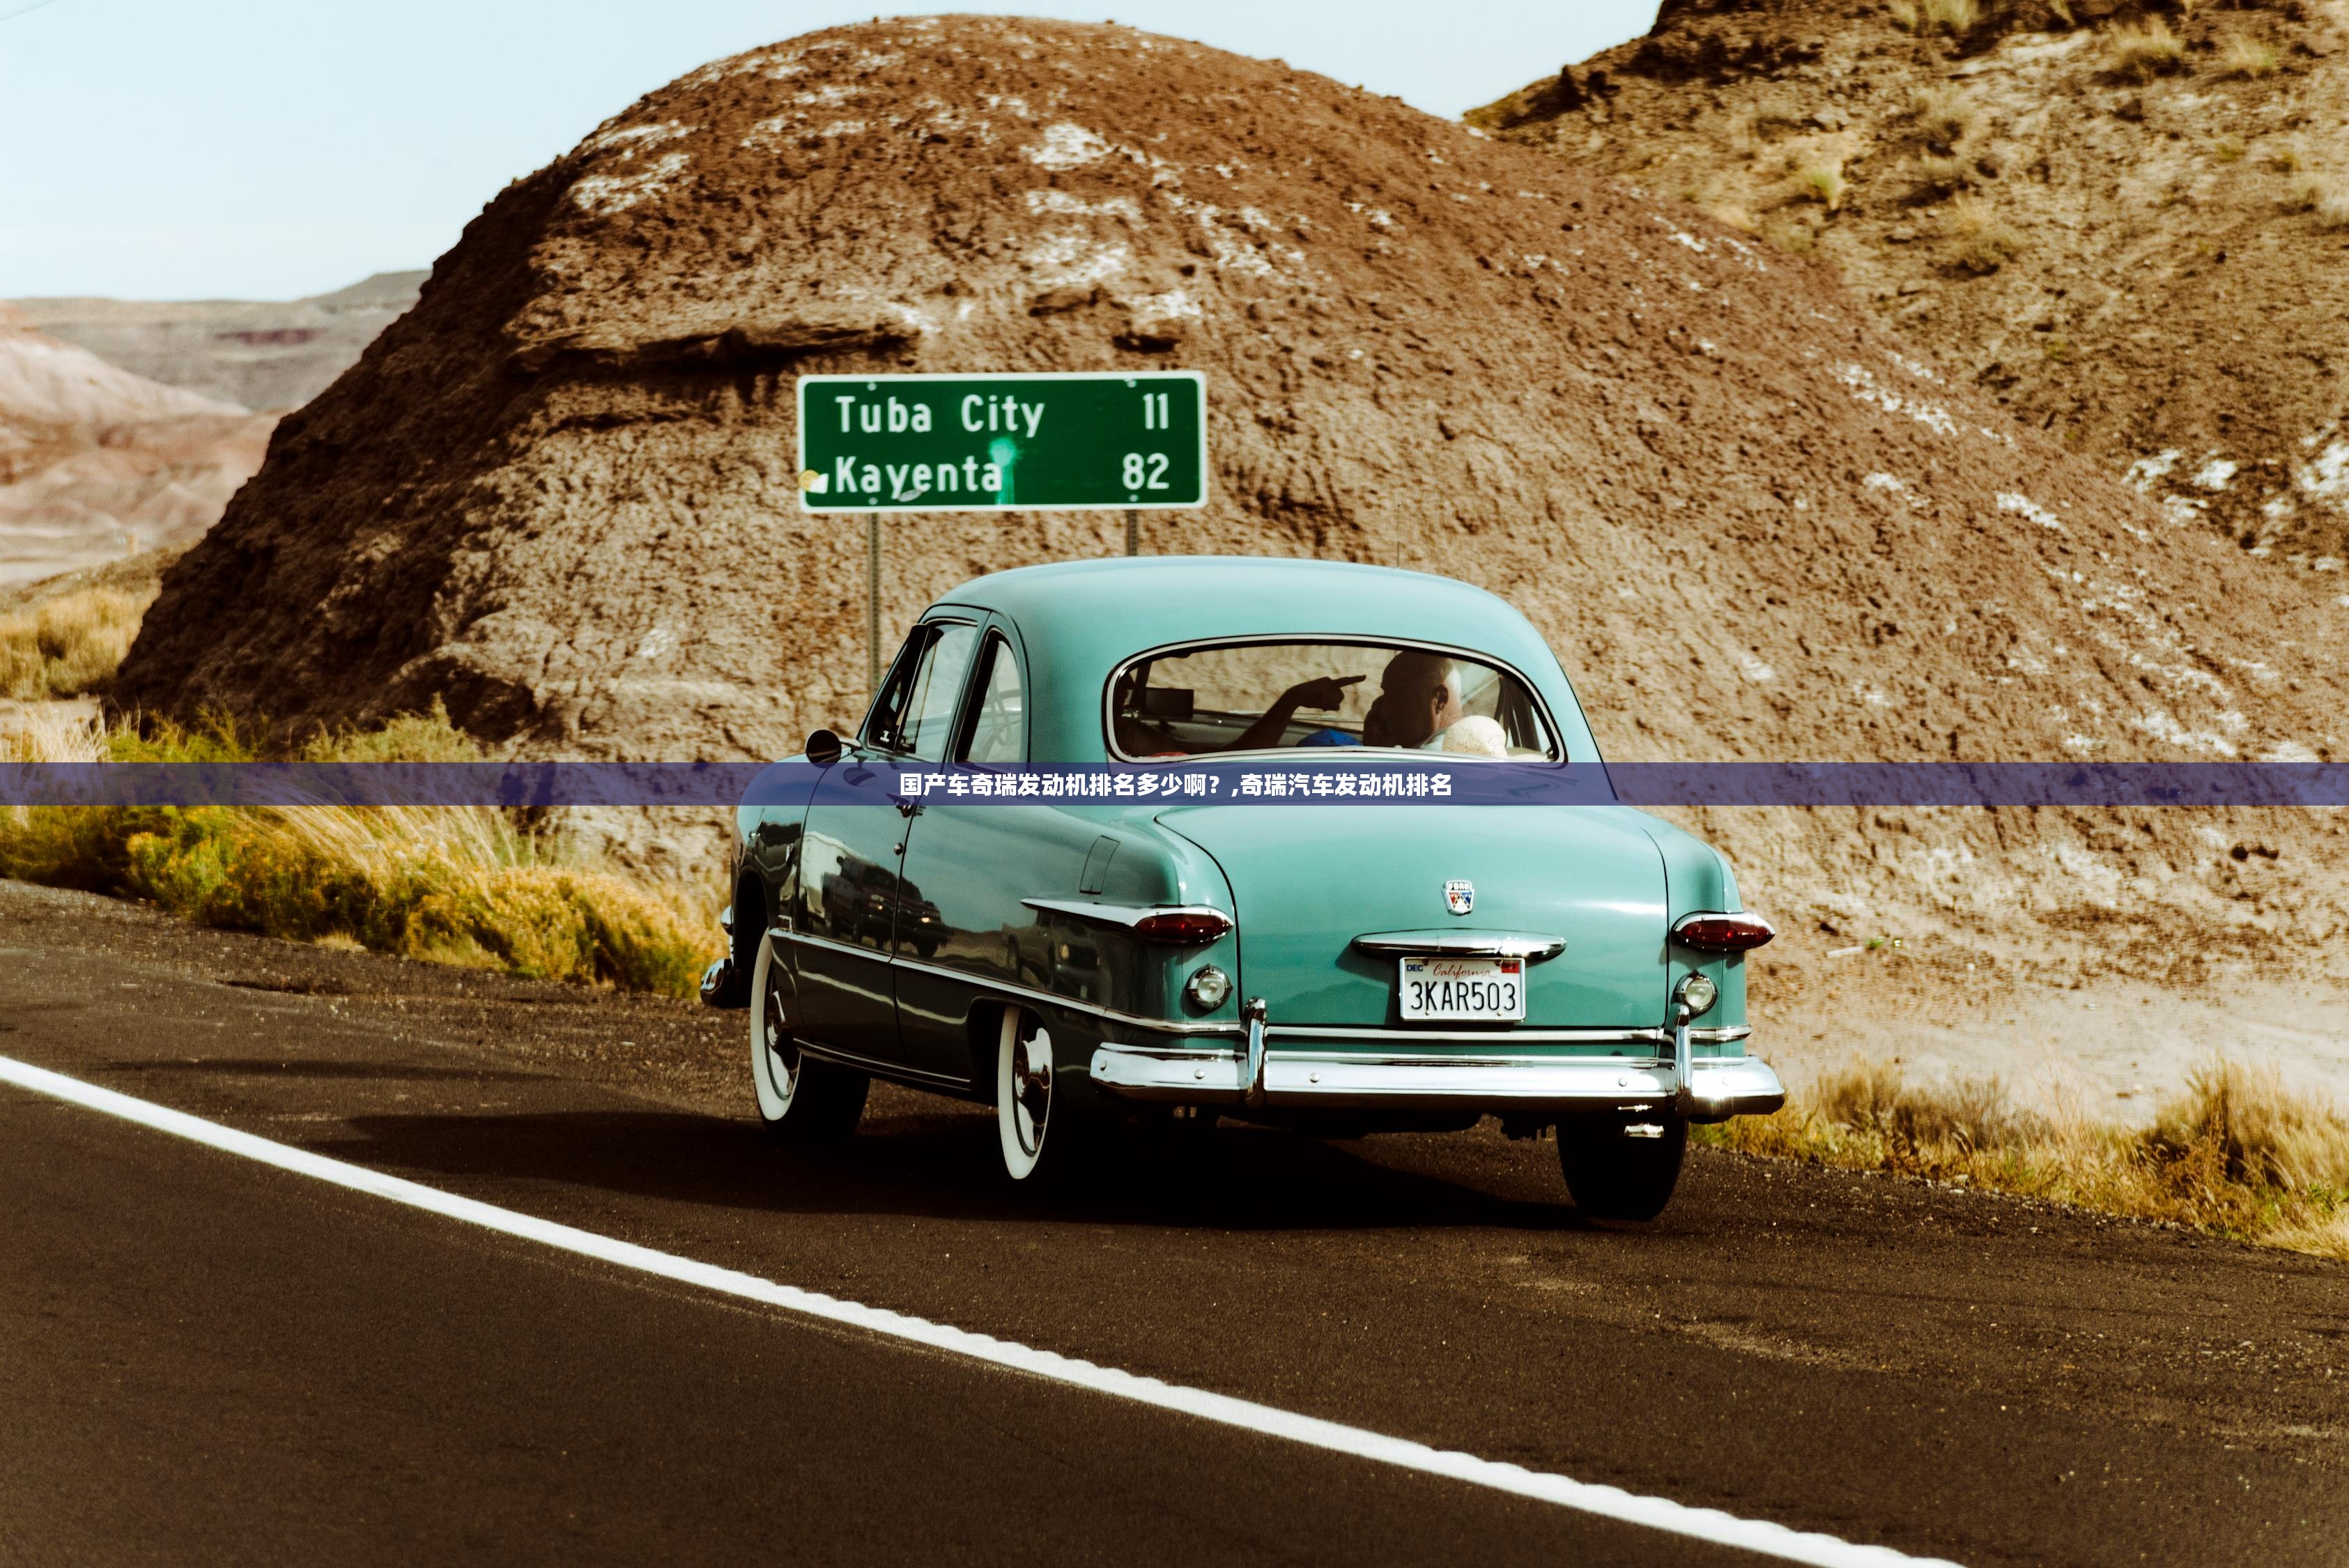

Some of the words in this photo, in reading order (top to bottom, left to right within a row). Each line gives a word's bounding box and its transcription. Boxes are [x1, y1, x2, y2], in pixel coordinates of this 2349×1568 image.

[835, 395, 932, 433] Tuba
[960, 394, 1045, 438] City
[1143, 392, 1169, 430] 11
[836, 456, 1003, 500] Kayenta
[1122, 453, 1169, 489] 82
[1406, 964, 1424, 972] DEC
[1433, 963, 1496, 979] California
[1410, 981, 1516, 1010] 3KAR503
